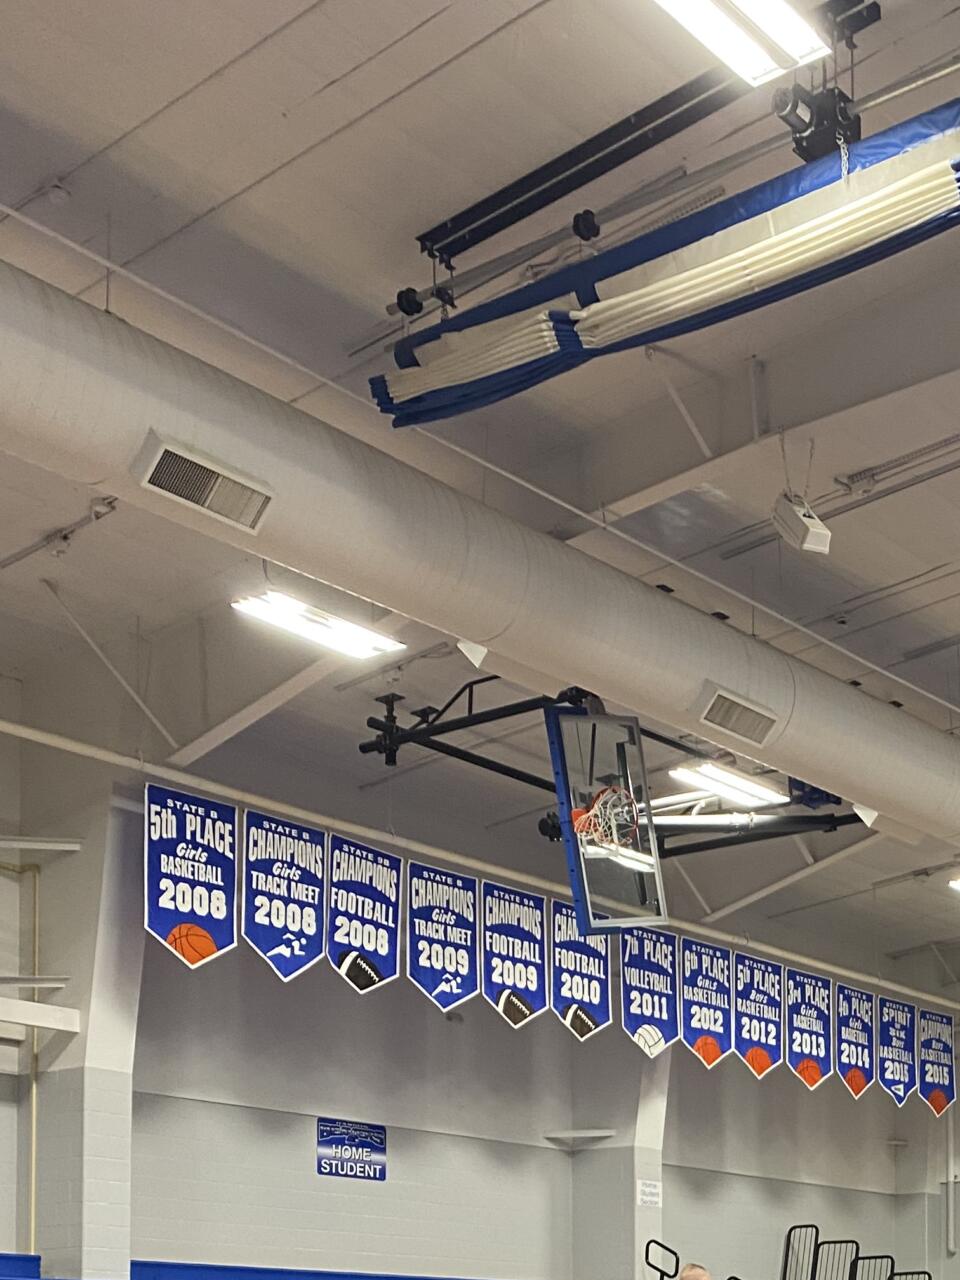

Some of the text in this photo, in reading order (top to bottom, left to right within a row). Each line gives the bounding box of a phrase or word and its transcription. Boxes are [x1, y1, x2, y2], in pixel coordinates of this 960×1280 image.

[167, 799, 217, 818] STATE B
[150, 804, 233, 860] 5th PLACE
[263, 821, 298, 836] STATE
[177, 843, 208, 862] Girls
[249, 827, 322, 879] CHAMPIONS
[342, 844, 374, 860] STATE
[161, 854, 224, 886] BASKETBALL
[273, 862, 301, 880] Girls
[332, 849, 397, 903] CHAMPIONS
[423, 871, 453, 884] STATE
[159, 878, 226, 919] 2008
[251, 871, 320, 905] TRACK MEET
[412, 877, 474, 922] CHAMPIONS
[494, 890, 520, 903] STATE
[254, 895, 316, 936] 2008
[331, 886, 395, 928] FOOTBALL
[432, 908, 456, 925] Girls
[486, 895, 541, 940] CHAMPIONS
[562, 908, 576, 917] STA
[334, 915, 388, 956] 2008
[414, 919, 472, 946] TRACK MEET
[633, 929, 656, 941] STATE
[418, 940, 469, 976] 2009
[486, 931, 541, 964] FOOTBALL
[624, 935, 672, 974] 7th PLACE
[692, 945, 713, 955] STATE
[491, 957, 537, 992] 2009
[555, 948, 605, 979] FOOTBALL
[684, 950, 729, 988] 6th PLACE
[745, 960, 765, 970] STATE
[561, 972, 600, 1005] 2010
[625, 966, 672, 994] VOLLEYBALL
[737, 964, 780, 1001] 5th PLACE
[796, 976, 815, 986] STATE
[630, 990, 668, 1020] 2011
[684, 985, 729, 1009] BASKETBALL
[737, 998, 779, 1021] BASKETBALL
[788, 980, 828, 1015] 3rd PLACE
[690, 1005, 724, 1033] 2012
[793, 1014, 824, 1034] BASKETBALL
[801, 1004, 817, 1018] Girls
[852, 997, 871, 1026] PLACE
[883, 1007, 911, 1028] SPIRIT
[742, 1016, 776, 1045] 2012
[792, 1031, 825, 1058] 2013
[841, 1042, 869, 1068] 2014
[880, 1045, 913, 1064] BASKETBALL
[884, 1060, 909, 1083] 2015
[925, 1063, 949, 1086] 2015
[332, 1144, 371, 1160] HOME
[321, 1159, 382, 1178] STUDENT
